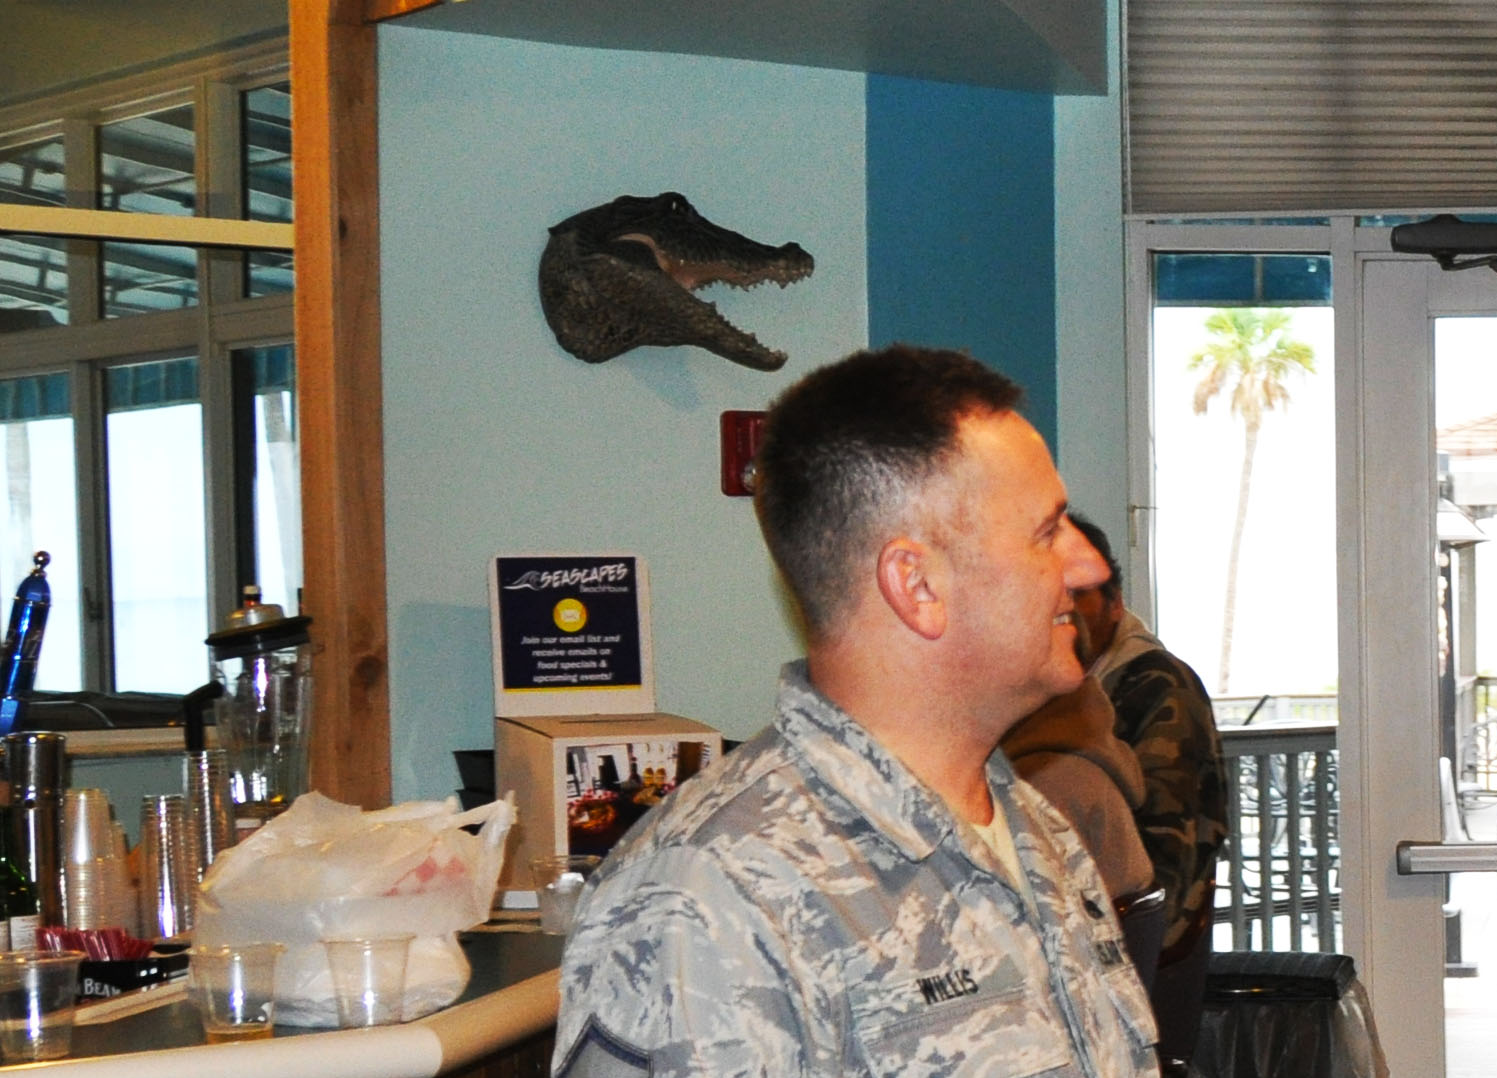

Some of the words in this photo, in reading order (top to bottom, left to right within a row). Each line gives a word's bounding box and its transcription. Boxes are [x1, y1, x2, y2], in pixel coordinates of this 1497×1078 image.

[540, 563, 628, 589] SEASCAPES
[521, 636, 541, 645] Join
[559, 635, 585, 643] email
[586, 635, 602, 643] list
[532, 648, 565, 656] receive
[567, 647, 597, 655] emails
[537, 661, 558, 669] food
[560, 660, 597, 669] specials
[599, 659, 607, 667] &
[533, 673, 577, 683] upcoming
[579, 672, 613, 681] events!
